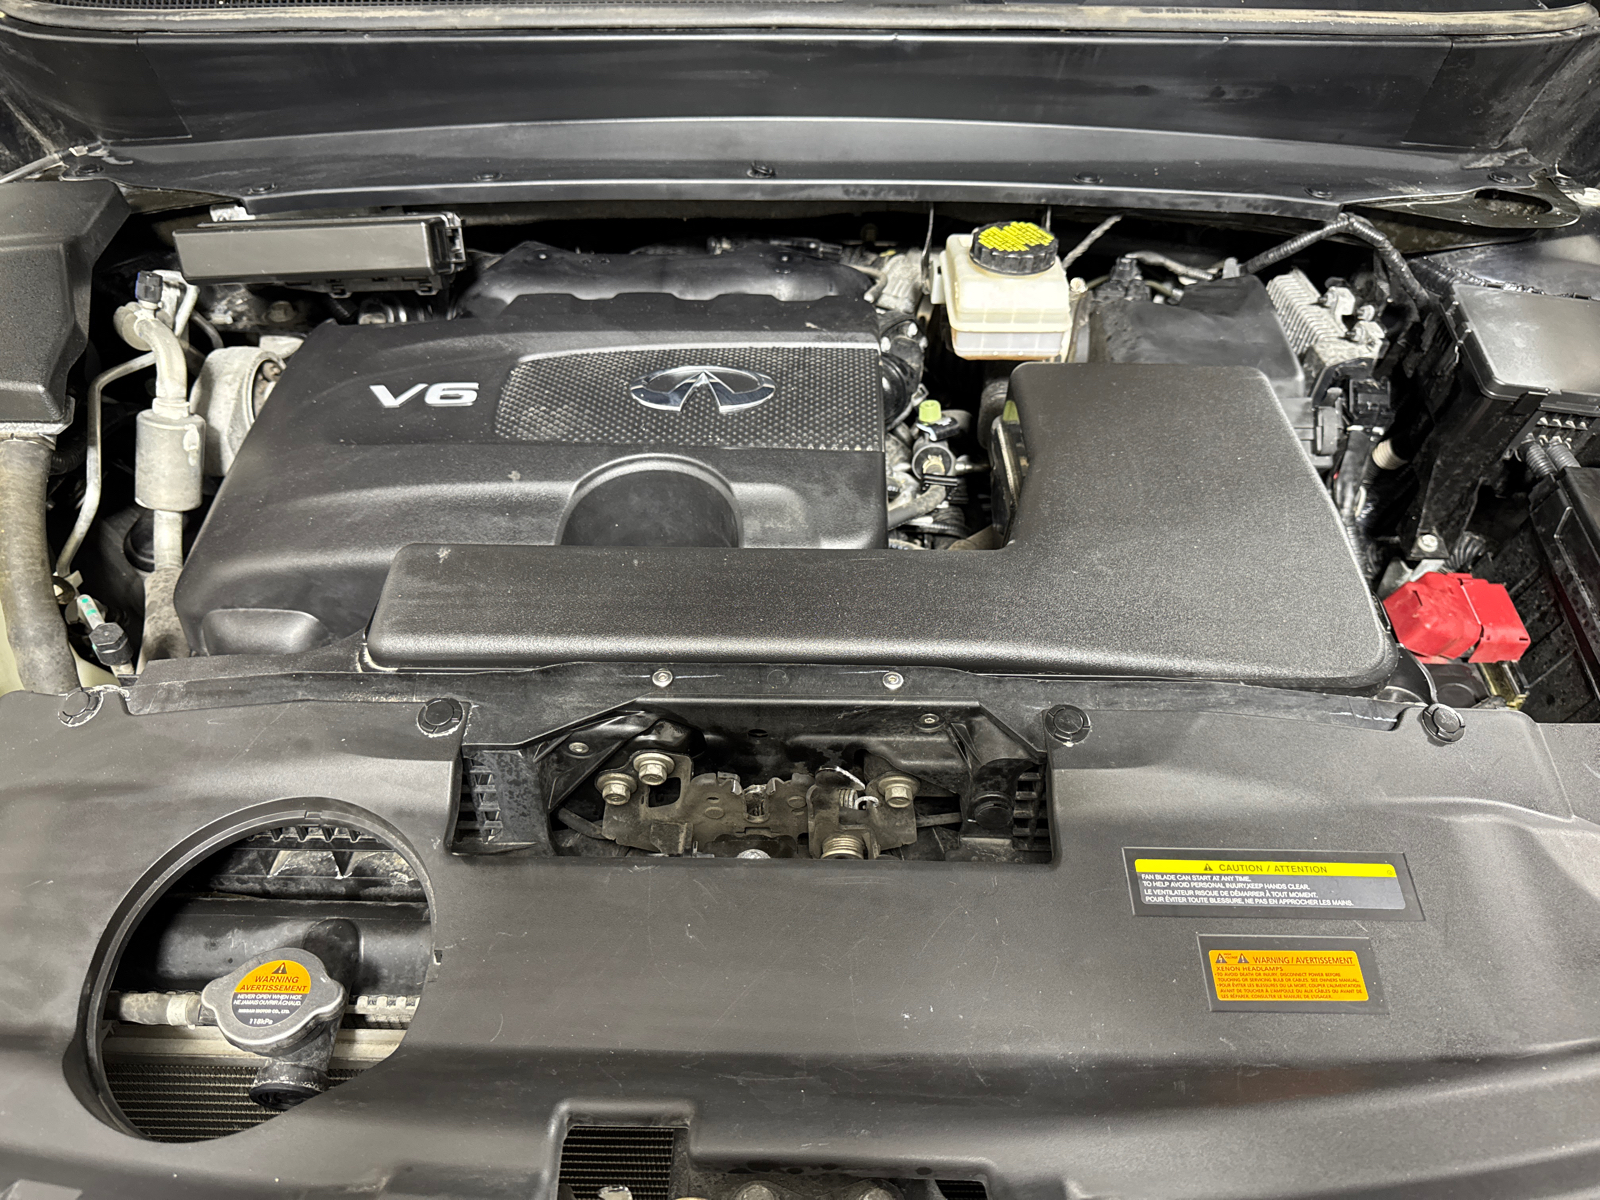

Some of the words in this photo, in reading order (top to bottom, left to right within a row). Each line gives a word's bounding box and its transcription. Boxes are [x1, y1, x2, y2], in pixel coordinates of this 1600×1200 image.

[369, 382, 479, 408] V6
[1219, 864, 1263, 872] CAUTION
[1274, 865, 1328, 873] ATTENTION
[1230, 889, 1265, 897] DÉMARRER
[255, 976, 300, 984] WARNING
